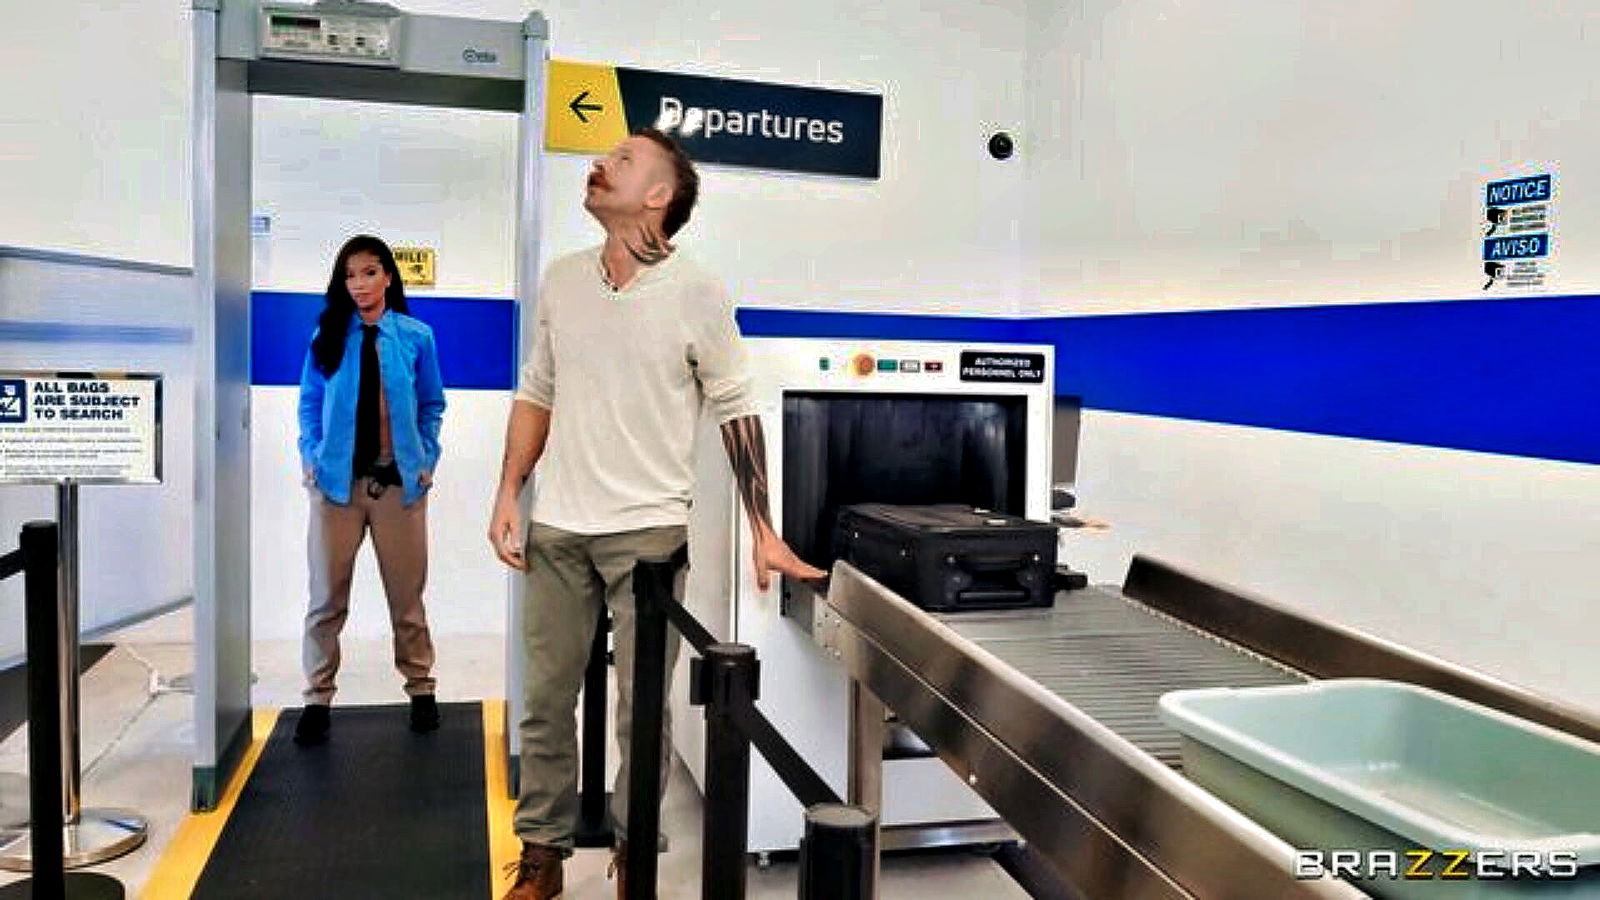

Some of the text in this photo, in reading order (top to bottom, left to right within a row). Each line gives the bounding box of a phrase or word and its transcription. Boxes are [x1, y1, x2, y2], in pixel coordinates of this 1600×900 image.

[1490, 181, 1548, 203] NOTICE
[1492, 237, 1540, 256] AVISO
[34, 382, 109, 393] ALL BAGS
[34, 395, 140, 407] ARE SUBJECT
[35, 409, 123, 420] TO SEARCH
